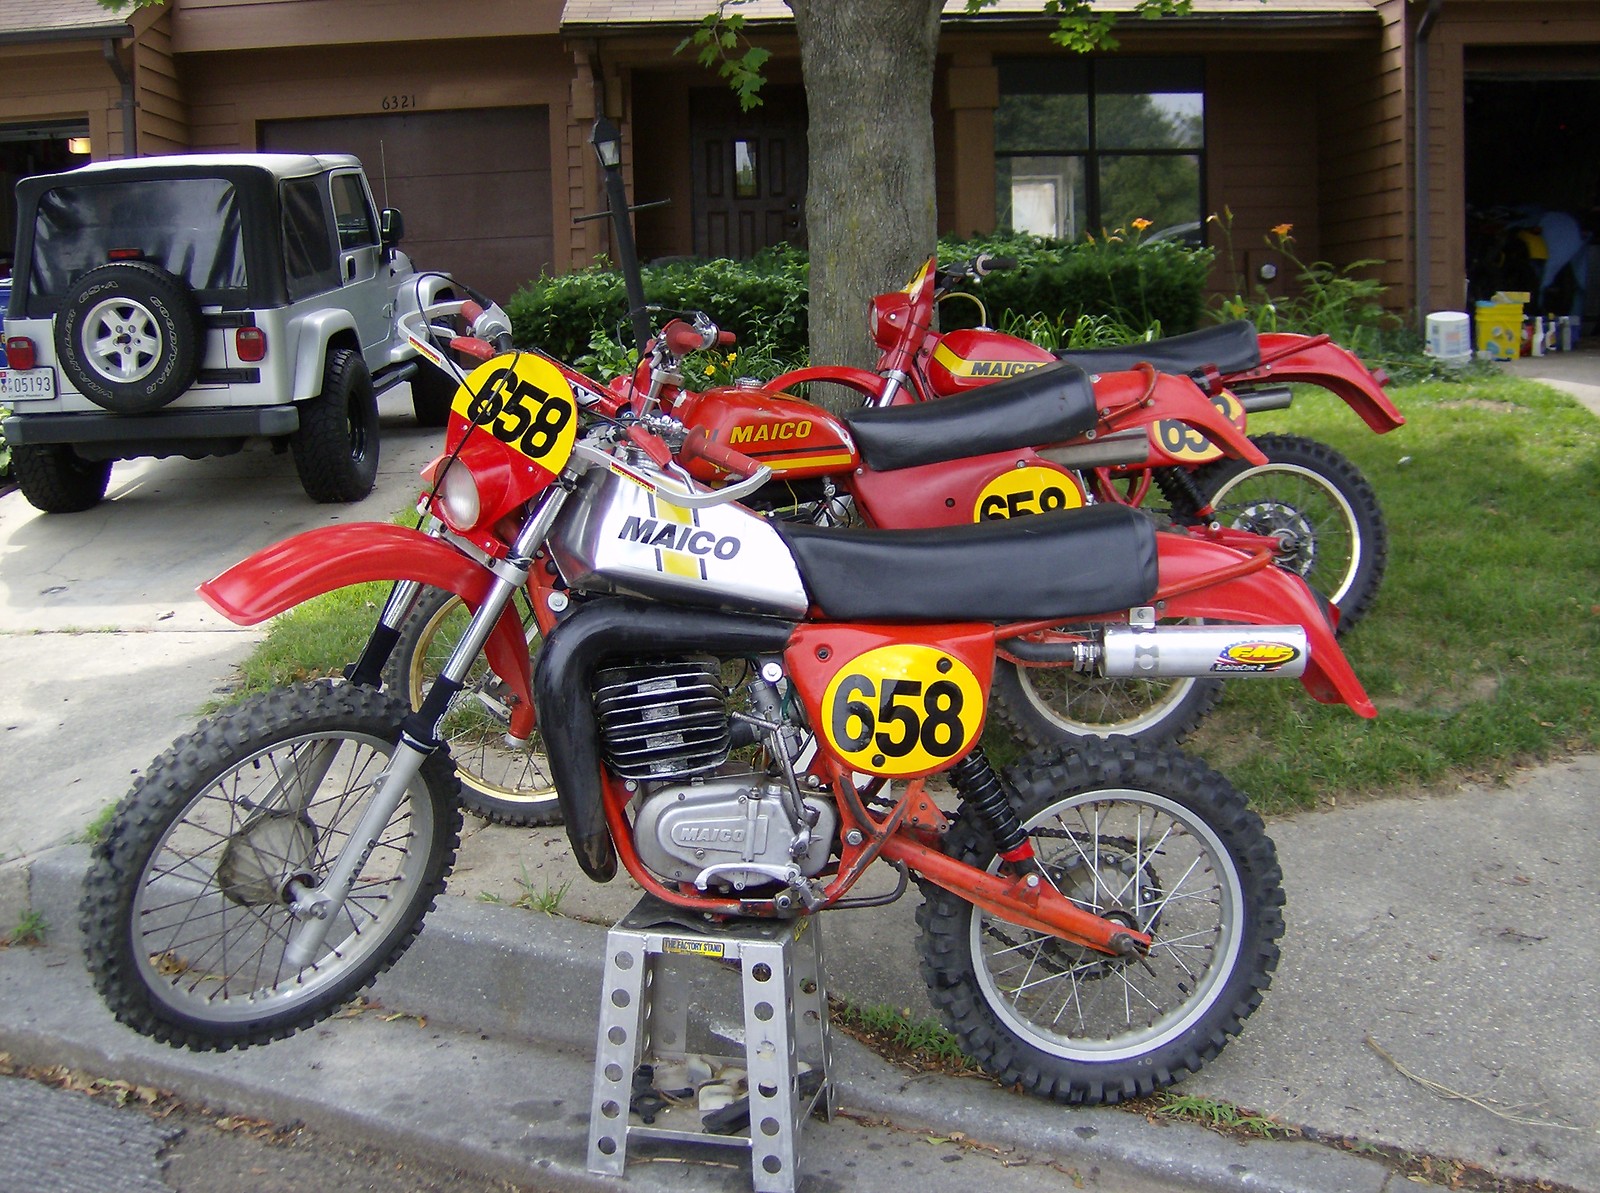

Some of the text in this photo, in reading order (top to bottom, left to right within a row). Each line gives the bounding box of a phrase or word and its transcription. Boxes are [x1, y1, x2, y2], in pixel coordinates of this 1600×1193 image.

[382, 95, 415, 110] 6321
[146, 296, 178, 395] GOODYEAR
[14, 376, 51, 393] 05193
[467, 368, 572, 458] 658
[730, 420, 813, 445] MAICO
[618, 515, 741, 560] MAICO
[1233, 645, 1294, 658] FMF
[832, 673, 965, 758] 658
[681, 827, 746, 843] MAICO
[665, 940, 677, 949] THE
[677, 940, 703, 951] FACTORY
[703, 943, 722, 953] STAND
